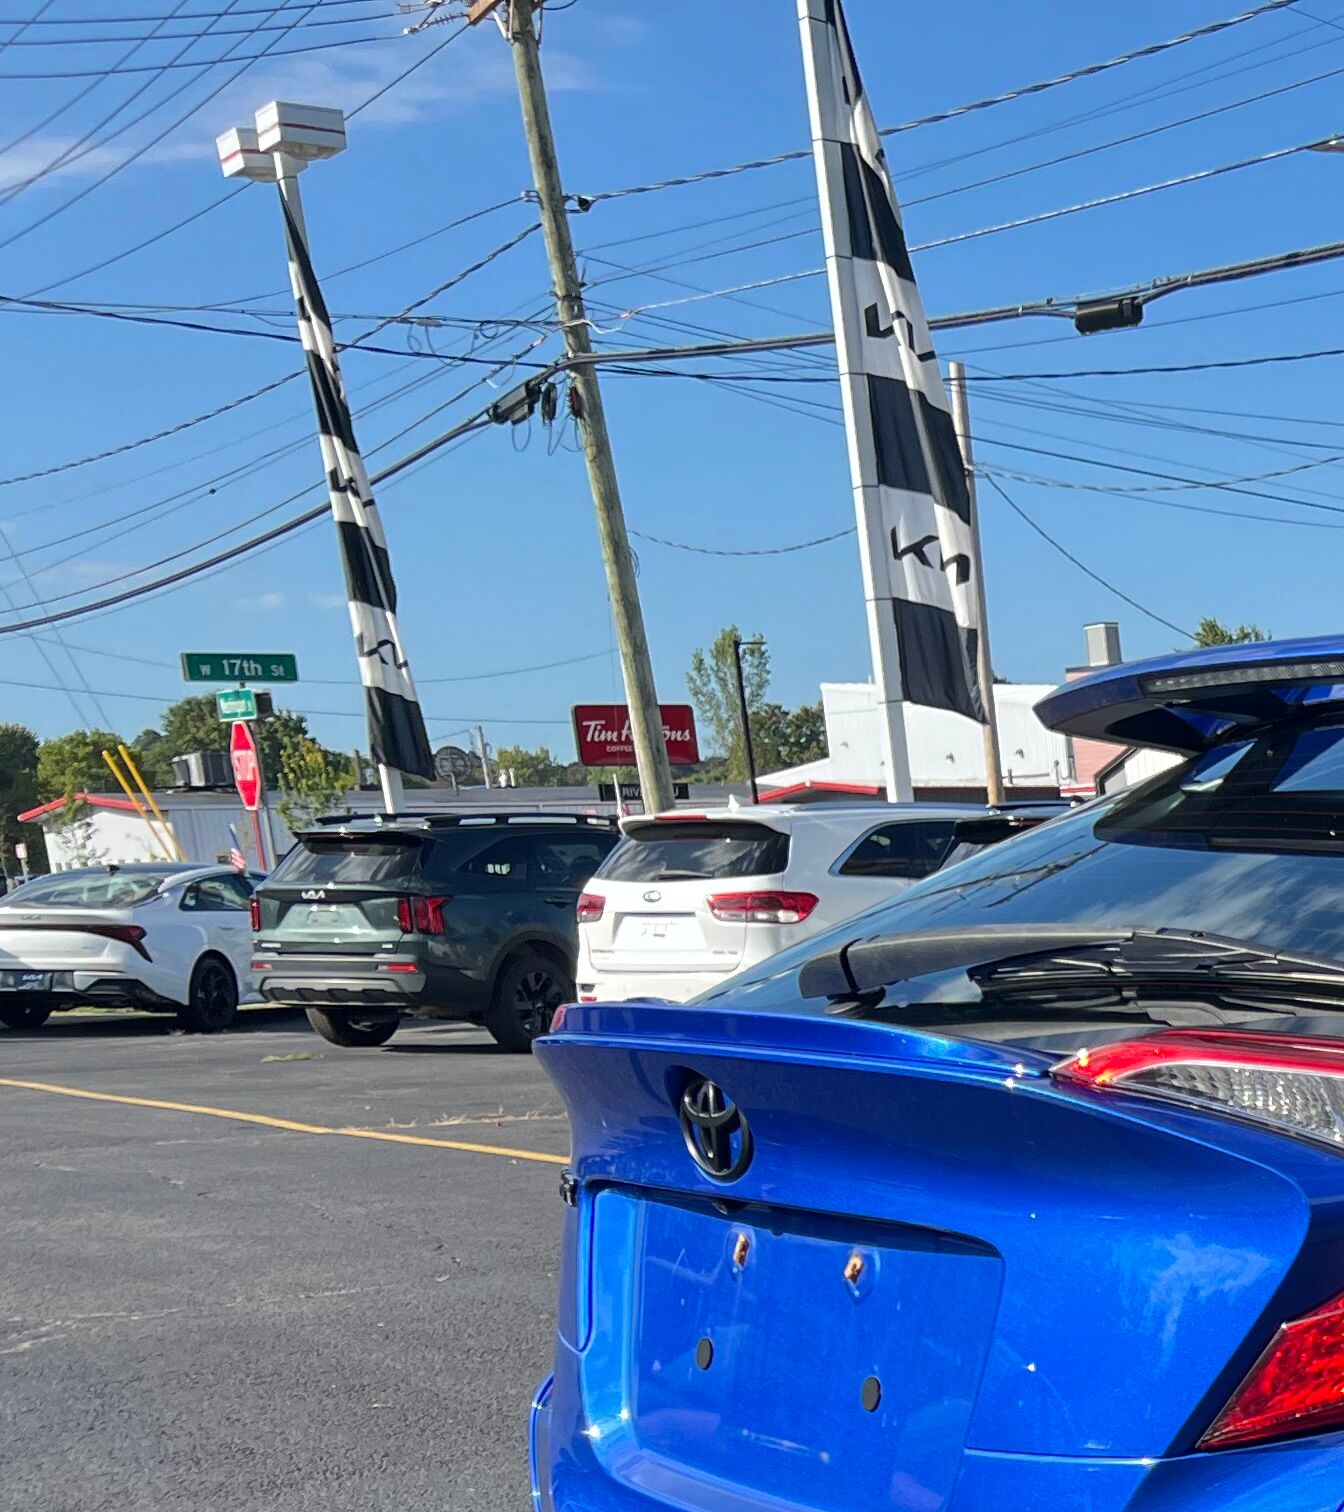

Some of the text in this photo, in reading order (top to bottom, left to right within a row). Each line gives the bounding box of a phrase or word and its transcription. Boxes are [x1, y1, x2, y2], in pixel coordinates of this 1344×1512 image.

[200, 659, 285, 677] W 17th St
[582, 719, 618, 742] Tim
